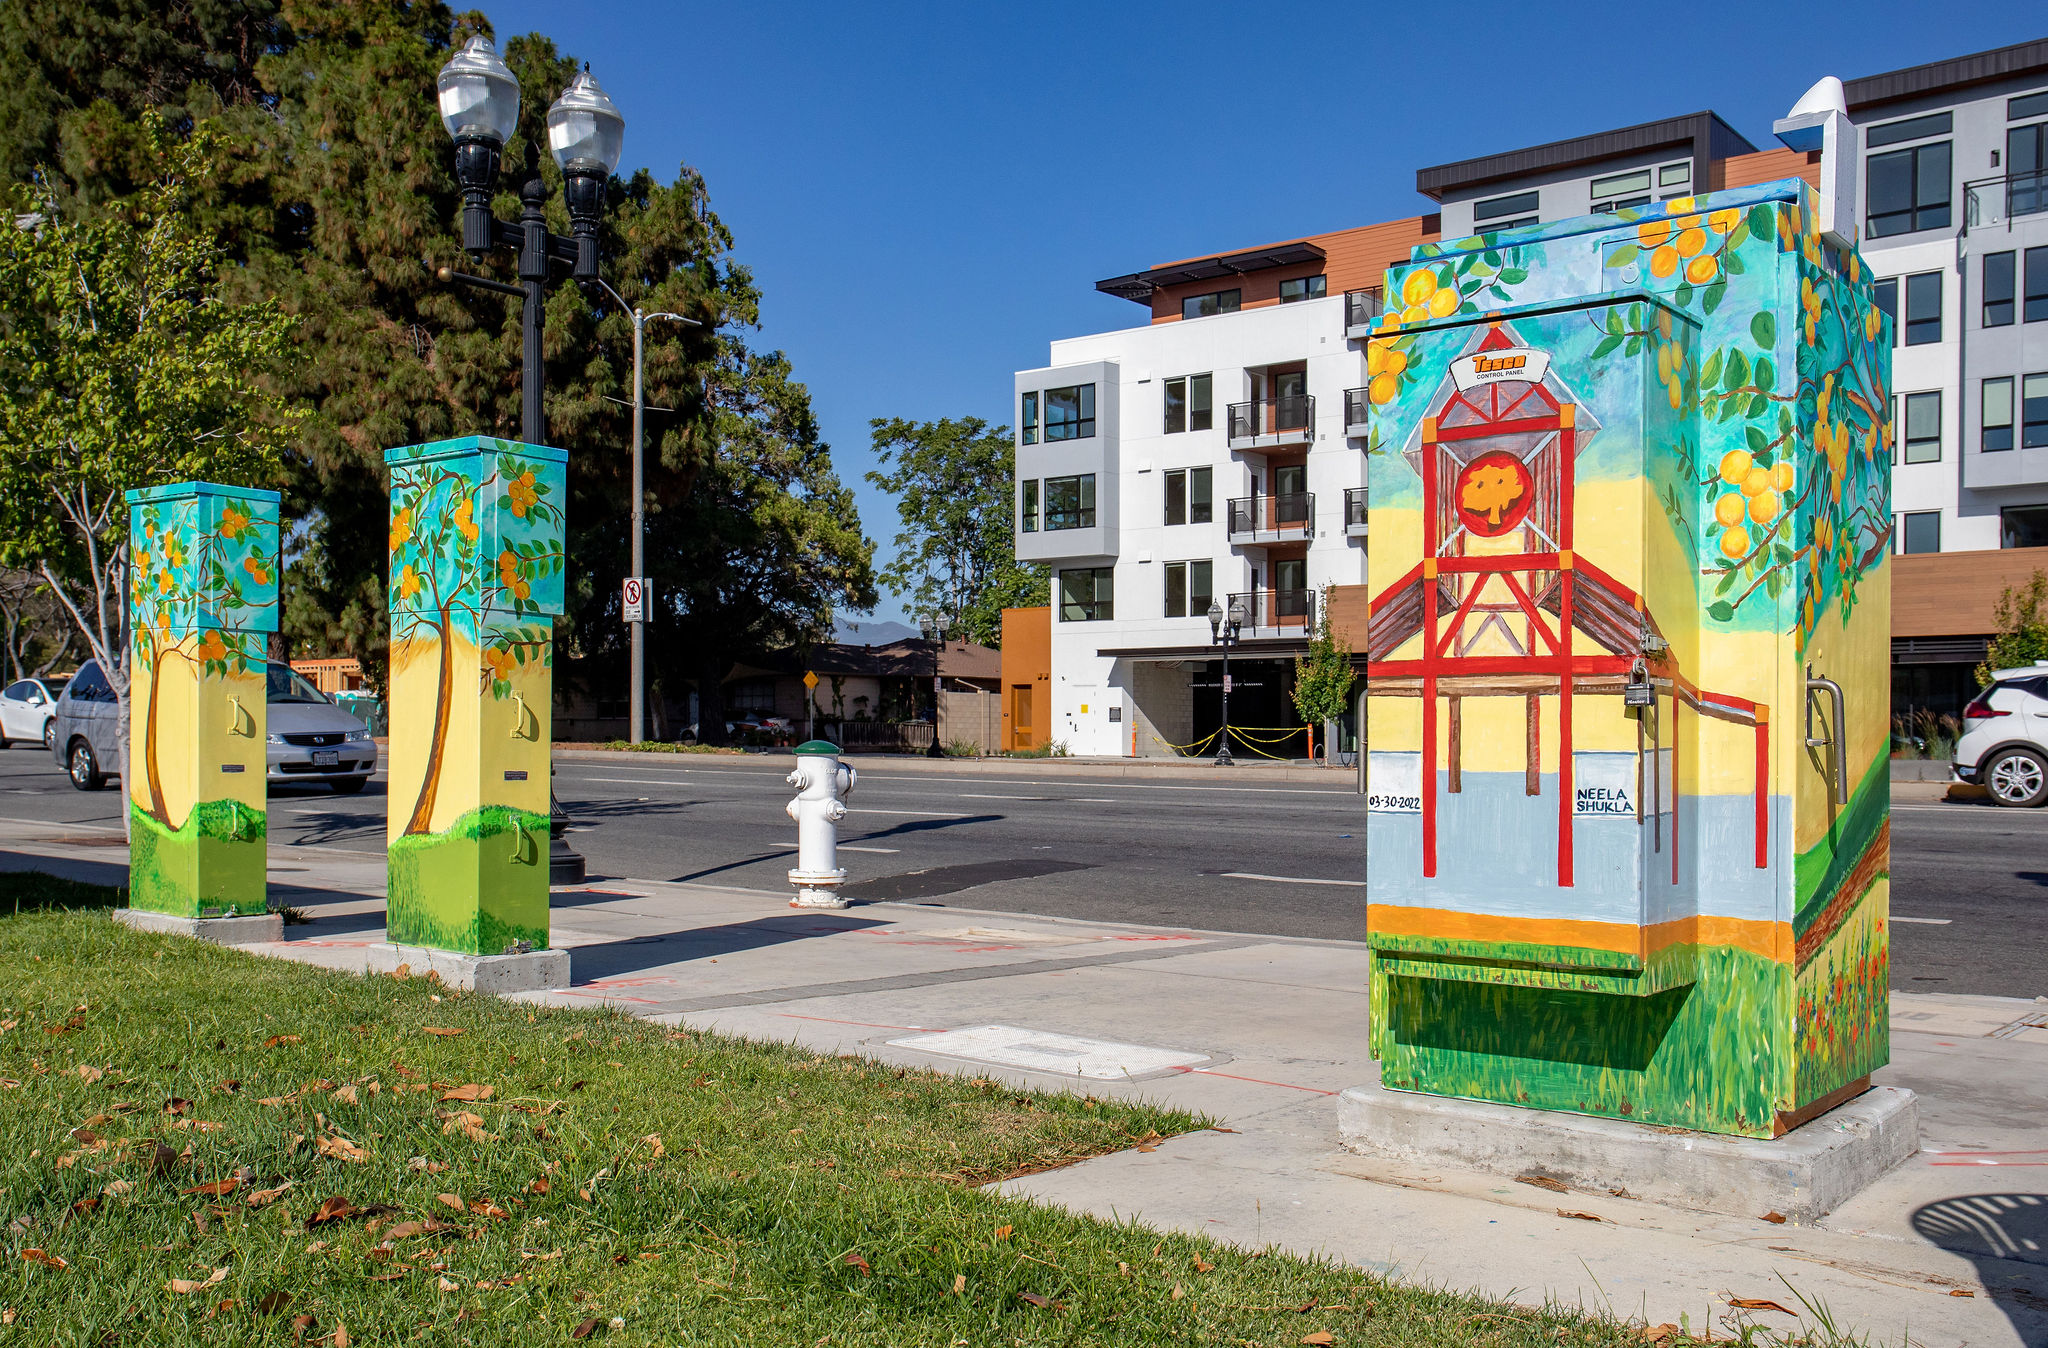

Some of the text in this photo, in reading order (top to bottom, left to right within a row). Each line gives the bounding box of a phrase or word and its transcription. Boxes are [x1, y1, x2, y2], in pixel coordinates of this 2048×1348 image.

[1472, 355, 1526, 373] TESCO
[1476, 369, 1524, 380] CONTROL PANEL
[1577, 787, 1627, 800] NEELA
[1576, 800, 1634, 813] SHUKLA
